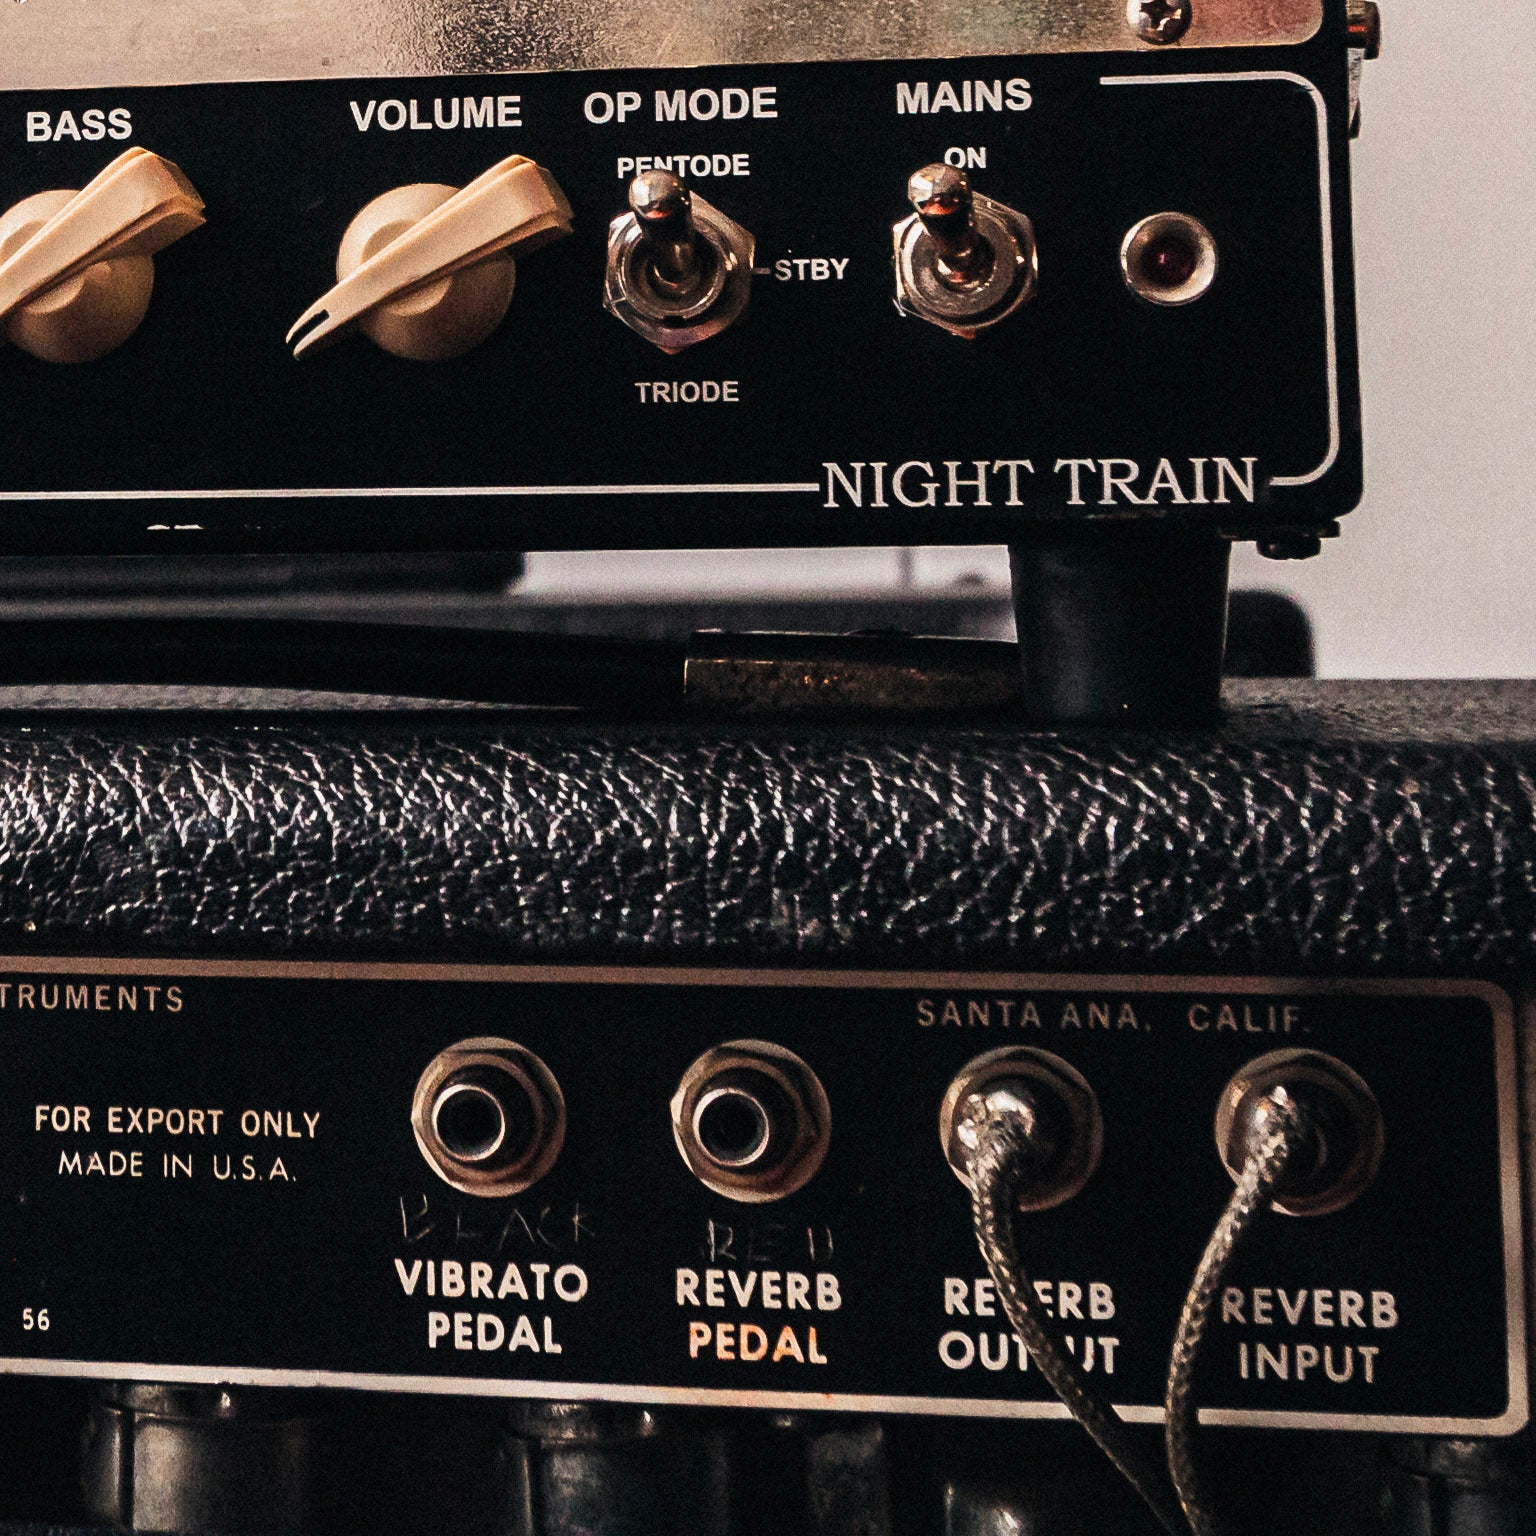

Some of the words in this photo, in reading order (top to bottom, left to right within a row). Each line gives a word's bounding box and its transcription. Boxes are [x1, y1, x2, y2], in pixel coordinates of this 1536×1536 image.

[350, 96, 522, 131] VOLUME
[584, 92, 641, 124] OP
[655, 87, 778, 121] MODE
[897, 78, 1032, 114] MAINS
[27, 108, 132, 142] BASS
[944, 147, 987, 170] ON
[776, 258, 849, 280] STBY
[635, 381, 739, 403] TRIODE
[821, 459, 1034, 510] NIGHT
[1054, 454, 1258, 506] TRAIN
[918, 1000, 1040, 1027] SANTA
[36, 1105, 90, 1132] FOR
[108, 1107, 223, 1134] EXPORT
[241, 1110, 319, 1138] ONLY
[59, 1151, 142, 1176] MADE
[164, 1154, 192, 1177] IN
[214, 1155, 296, 1181] U.S.A.
[395, 1259, 588, 1302] VIBRATO
[677, 1268, 841, 1310] REVERB
[944, 1277, 1116, 1321] REERB
[1223, 1288, 1398, 1328] REVERB
[23, 1308, 49, 1330] 56
[429, 1312, 562, 1353] PEDAL
[690, 1322, 827, 1364] PEDAL
[938, 1330, 1120, 1374] OUTUT
[1240, 1343, 1379, 1383] INPUT
